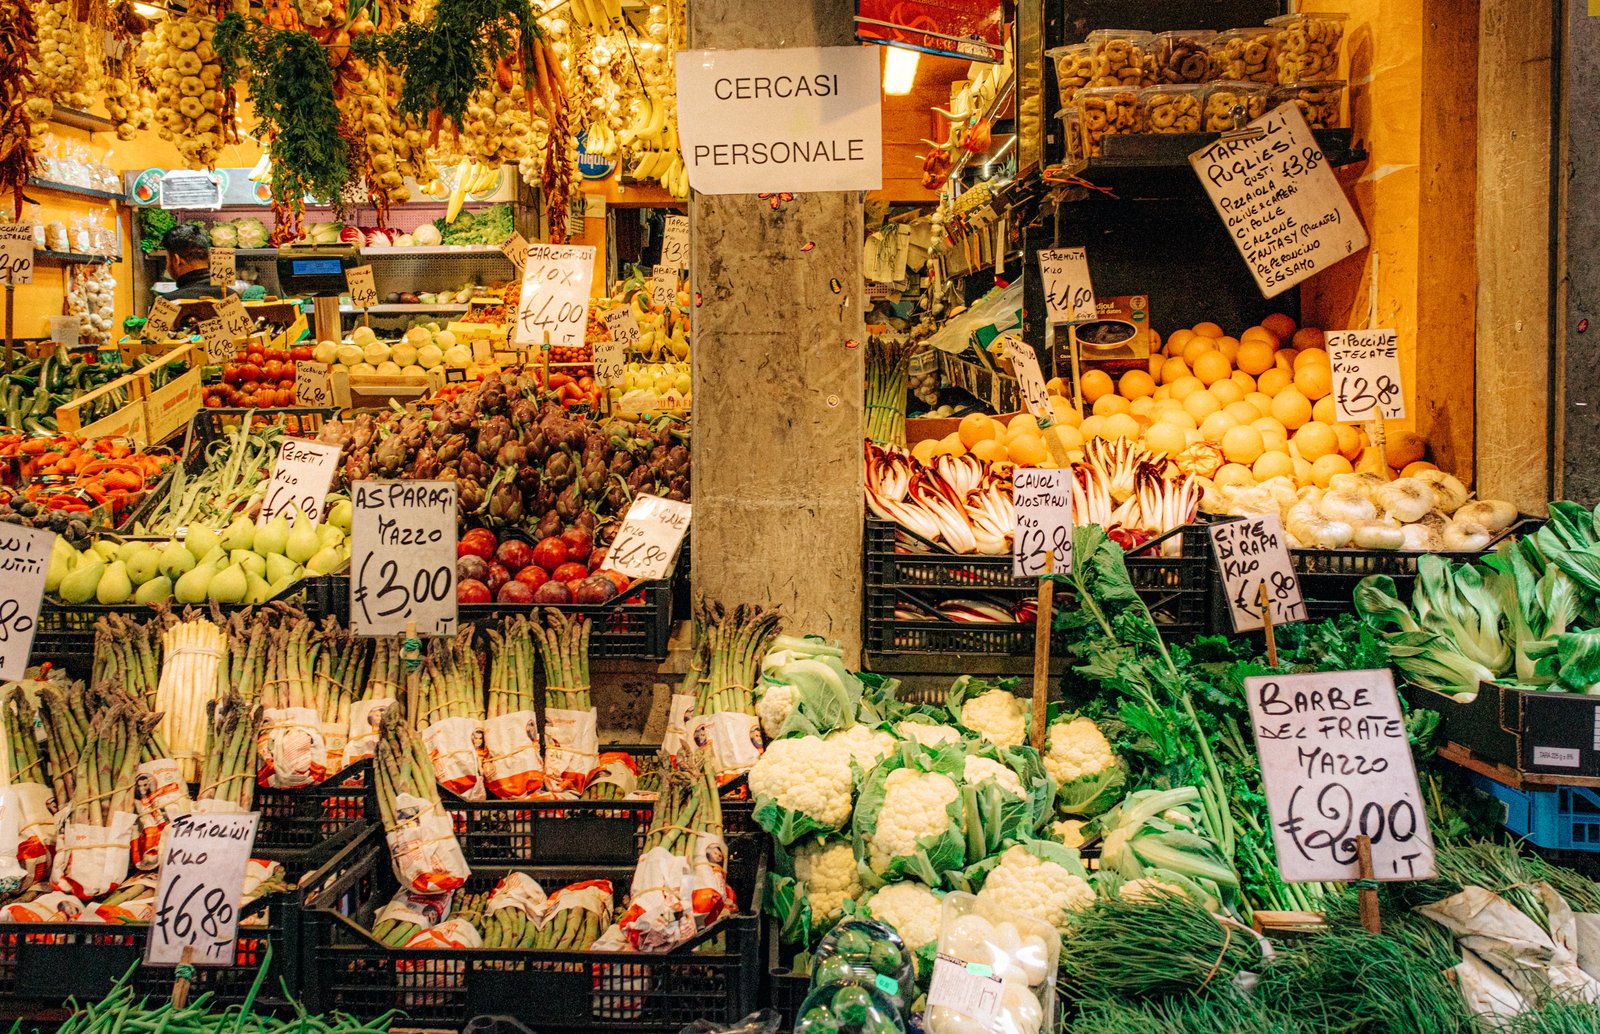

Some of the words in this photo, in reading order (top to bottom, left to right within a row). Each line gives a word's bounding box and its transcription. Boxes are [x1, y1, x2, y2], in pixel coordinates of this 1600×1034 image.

[714, 74, 839, 101] CERCASI
[694, 139, 864, 167] PERSONALE
[1208, 131, 1296, 187] PUGLIESI
[1244, 162, 1274, 187] GUSTI
[1220, 180, 1277, 214] PIZZAIOLA
[1229, 205, 1258, 227] OLIVE
[1237, 206, 1285, 238] CIPOLLE
[0, 226, 31, 234] CCHINE
[1243, 217, 1297, 251] CALZONE
[1042, 250, 1085, 261] SPREMUTA
[1247, 230, 1298, 266] FANTASY
[1257, 240, 1320, 278] PEPERONCINO
[653, 267, 677, 275] ABATE
[520, 293, 583, 333] €4,00
[1096, 302, 1114, 310] djoul
[1328, 333, 1398, 347] CIPOLLINE
[1333, 363, 1360, 373] KILO
[1386, 407, 1401, 418] IT
[1014, 470, 1061, 489] CAVOLI
[356, 483, 455, 514] ASPARAGI
[1015, 489, 1069, 507] NOSTRANI
[378, 514, 442, 545] MAZZO
[623, 522, 645, 537] KILO
[1214, 520, 1264, 543] CIME
[0, 534, 35, 552] NI
[1218, 540, 1234, 560] DI
[1239, 534, 1279, 556] RAPA
[1223, 560, 1260, 582] KILO
[354, 551, 452, 625] €3,00
[1284, 602, 1303, 622] IT
[435, 617, 454, 635] IT
[1259, 682, 1372, 716] BARBE
[1259, 723, 1307, 740] DEL
[1318, 716, 1403, 740] FRATE
[1298, 746, 1389, 779] MAZZO
[167, 848, 208, 866] KILO
[1393, 853, 1421, 878] IT
[156, 874, 233, 945] €6,80
[206, 939, 233, 958] IT
